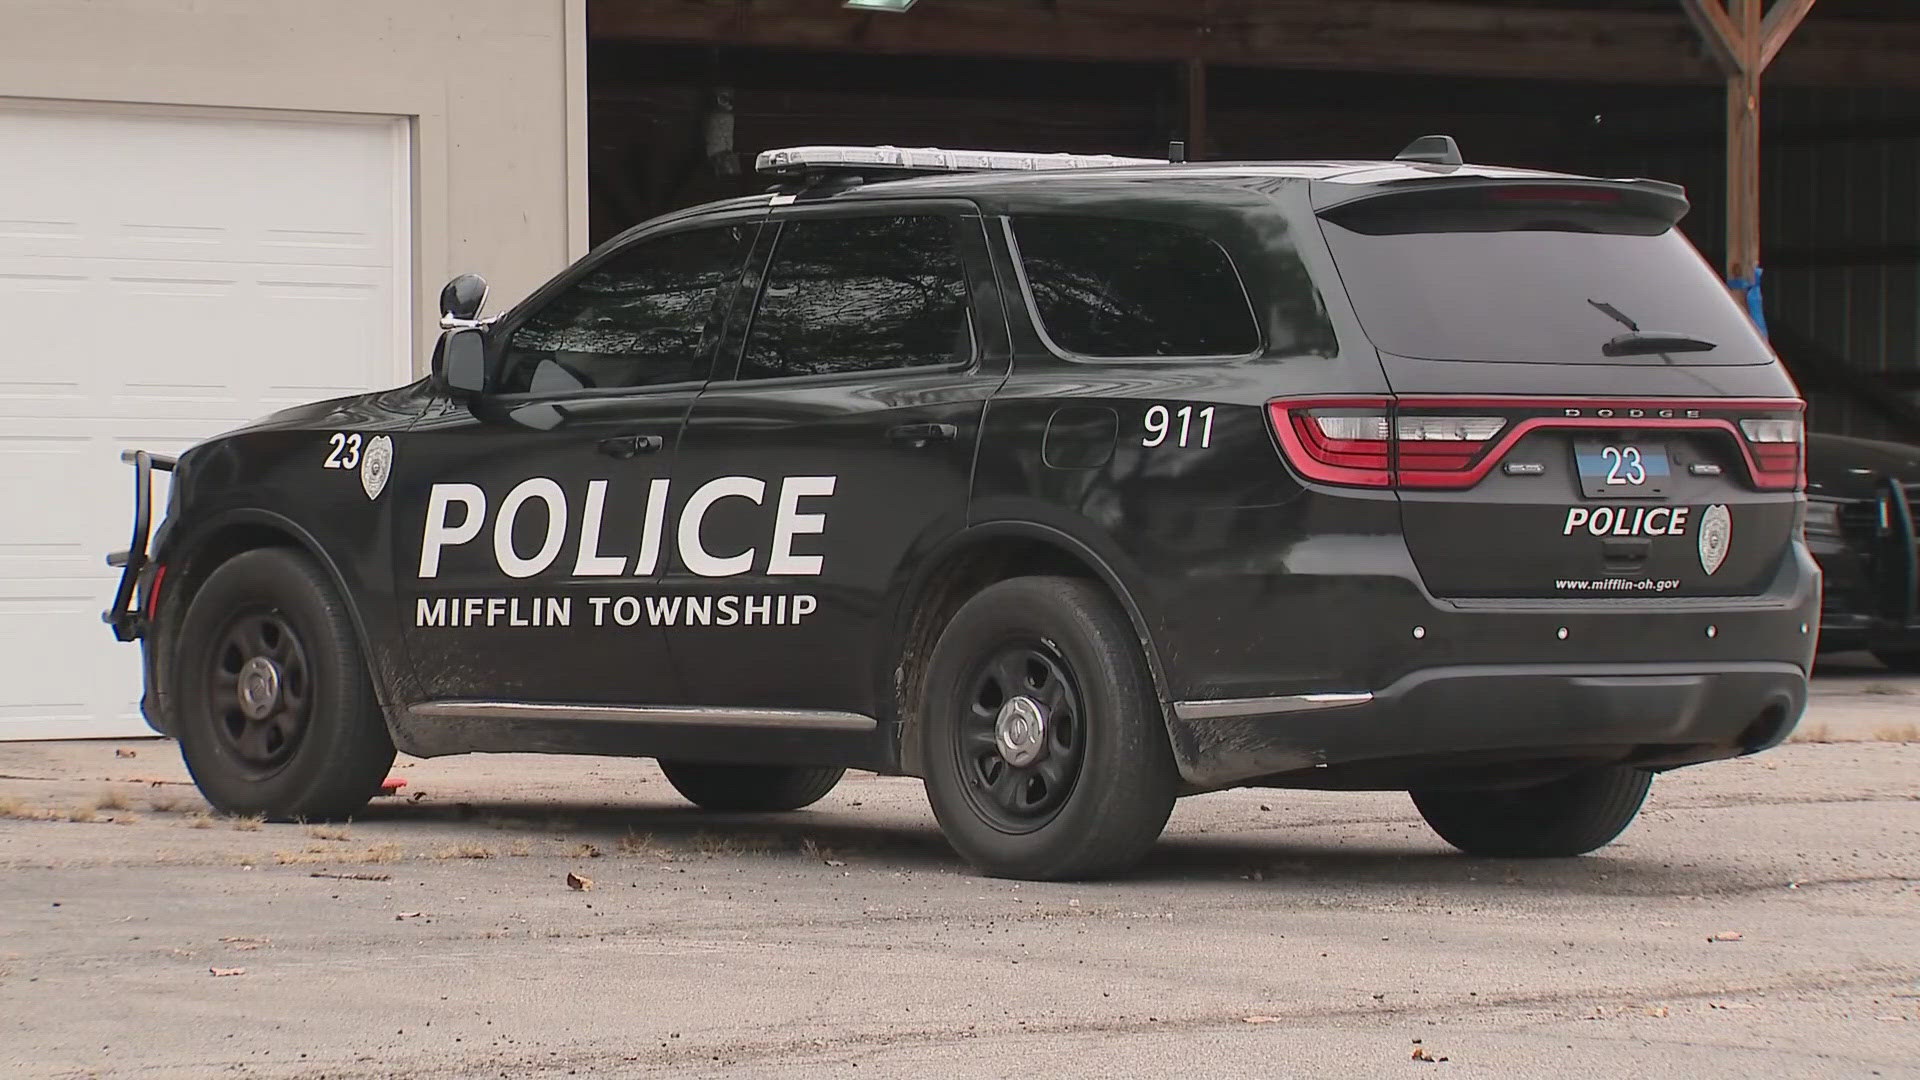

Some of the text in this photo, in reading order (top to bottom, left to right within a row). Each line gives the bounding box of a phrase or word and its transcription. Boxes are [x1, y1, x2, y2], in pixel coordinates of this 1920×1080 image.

[1142, 405, 1215, 448] 911
[1565, 409, 1700, 417] DODGE
[323, 432, 362, 470] 23
[1602, 446, 1646, 485] 23
[418, 475, 837, 579] POLICE
[1563, 507, 1689, 536] POLICE
[1555, 578, 1680, 592] www.mifflin-oh.gov
[416, 595, 818, 627] MIFFLIN TOWNSHIP
